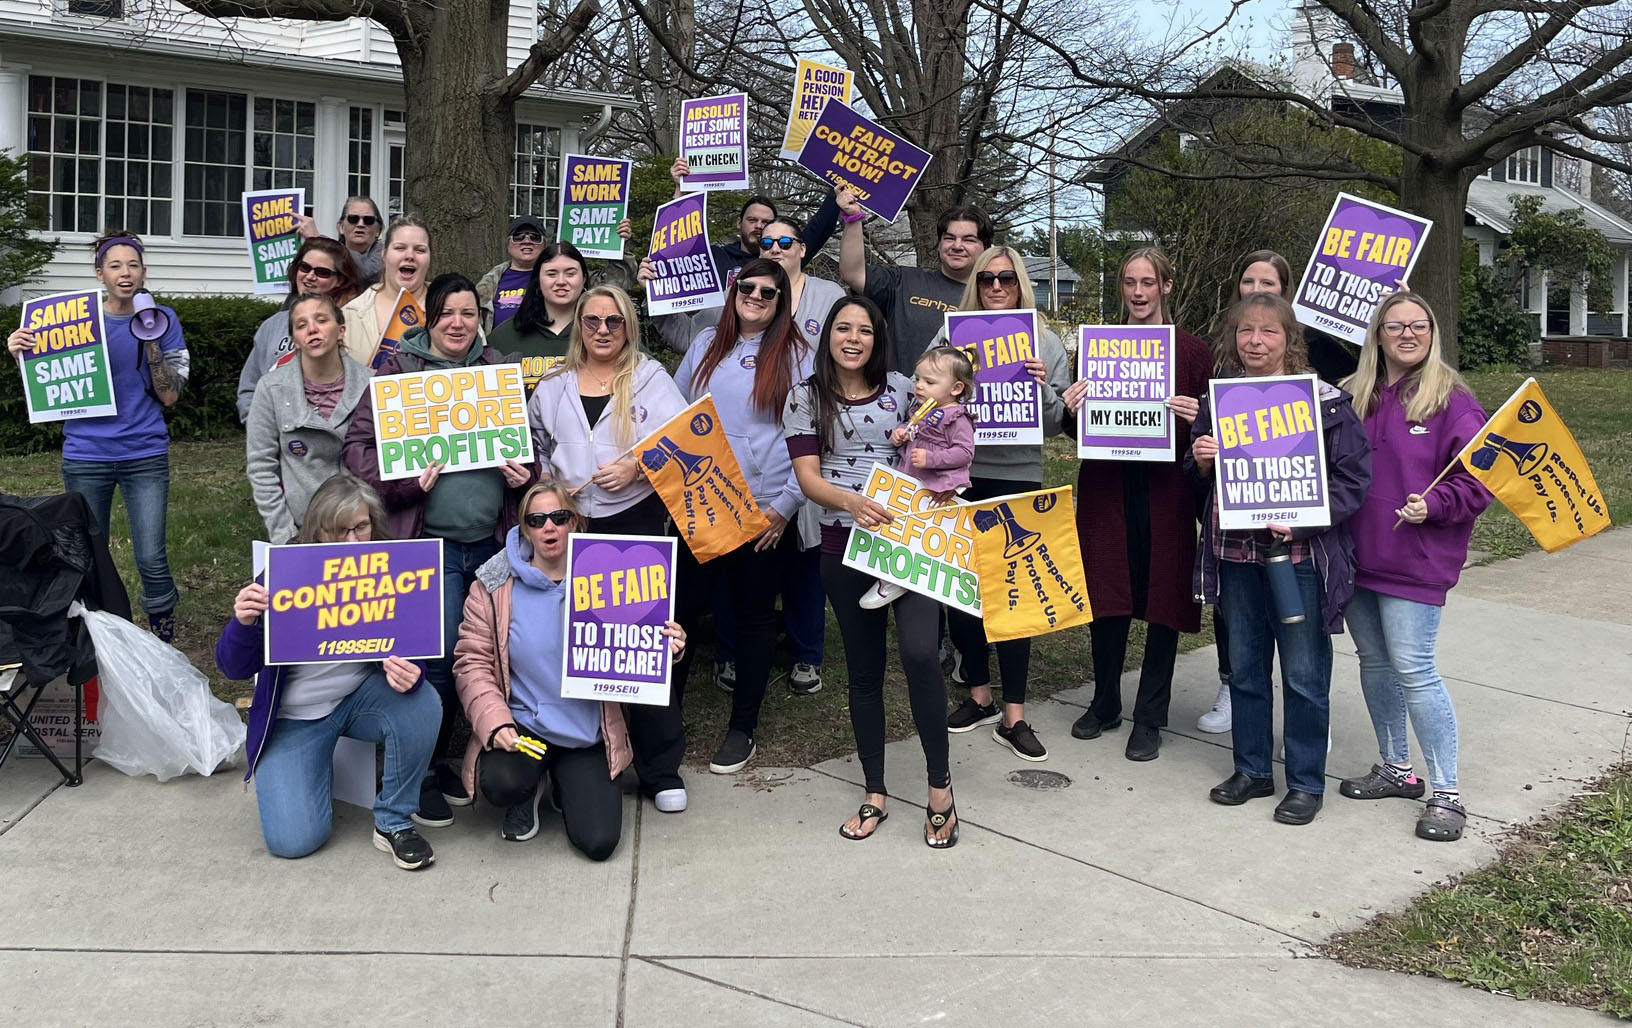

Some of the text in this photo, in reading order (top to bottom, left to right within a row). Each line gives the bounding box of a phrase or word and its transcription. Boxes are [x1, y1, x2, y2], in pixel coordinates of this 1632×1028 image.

[805, 68, 844, 84] A GOOD
[803, 82, 844, 97] PENSION
[688, 103, 740, 120] ABSOLUT:
[798, 110, 819, 120] RETE
[686, 117, 740, 134] PUT SOME
[686, 131, 740, 147] RESPECT IN
[850, 125, 896, 155] FAIR
[688, 153, 738, 166] MY CHECK!
[815, 125, 918, 180] CONTRACT
[573, 164, 622, 182] SAME
[832, 151, 885, 184] NOW!
[570, 184, 622, 202] WORK
[252, 197, 294, 220] SAME
[568, 208, 618, 225] SAME
[252, 216, 293, 239] WORK
[572, 227, 610, 244] PAY!
[651, 210, 703, 254] BE FAIR
[258, 238, 297, 261] SAME
[1322, 227, 1412, 268] BE FAIR
[265, 258, 294, 280] PAY
[667, 254, 710, 275] THOSE
[1312, 263, 1335, 286] TO
[652, 271, 714, 296] WHO CARE!
[29, 296, 90, 330] SAME
[672, 297, 704, 307] 1199SEIU
[910, 296, 958, 312] carha
[1305, 282, 1376, 324] WHO CARE
[1314, 315, 1354, 334] 1199SEIU
[32, 321, 96, 354] WORK
[983, 332, 1032, 368] FAIR
[1088, 338, 1164, 359] ABSOLUT:
[35, 351, 98, 384] SAME
[1088, 360, 1165, 380] PUT SOME
[46, 377, 94, 406] PAY!
[375, 368, 521, 410] PEOPLE
[980, 382, 1033, 402] THOSE
[1087, 380, 1165, 399] RESPECT IN
[378, 398, 525, 440] BEFORE
[993, 403, 1034, 423] CARE!
[1091, 410, 1161, 426] MY CHECK!
[1218, 400, 1314, 449] BE FAIR
[382, 426, 529, 474] PROFITS!
[1224, 456, 1316, 480] TO THOSE
[712, 466, 742, 500] Respect
[1226, 479, 1318, 504] WHO CARE!
[1550, 452, 1603, 516] Respect Us.
[696, 485, 715, 526] Pay Us.
[706, 477, 742, 529] Protect Us.
[867, 468, 973, 538] PEOPL
[1528, 474, 1558, 523] Pay Us.
[1542, 464, 1584, 534] Protect Us.
[684, 490, 696, 540] Staff Us.
[1251, 512, 1298, 521] 1199SEIU
[323, 552, 390, 581] FAIR
[848, 529, 981, 610] PROFITS!
[1036, 544, 1084, 612] Respect Us.
[272, 568, 435, 612] CONTRACT
[573, 564, 667, 612] BE FAIR
[1005, 560, 1018, 611] Pay Us.
[1022, 554, 1057, 628] Protect Us.
[318, 597, 396, 630] NOW!
[317, 638, 395, 656] 1199SEIU
[573, 622, 664, 650] TO THOSE
[572, 647, 662, 676] WHO CARE!
[593, 683, 640, 694] 1199SEIU
[30, 716, 70, 724] UNITED
[36, 728, 102, 737] OSTAL SERV
